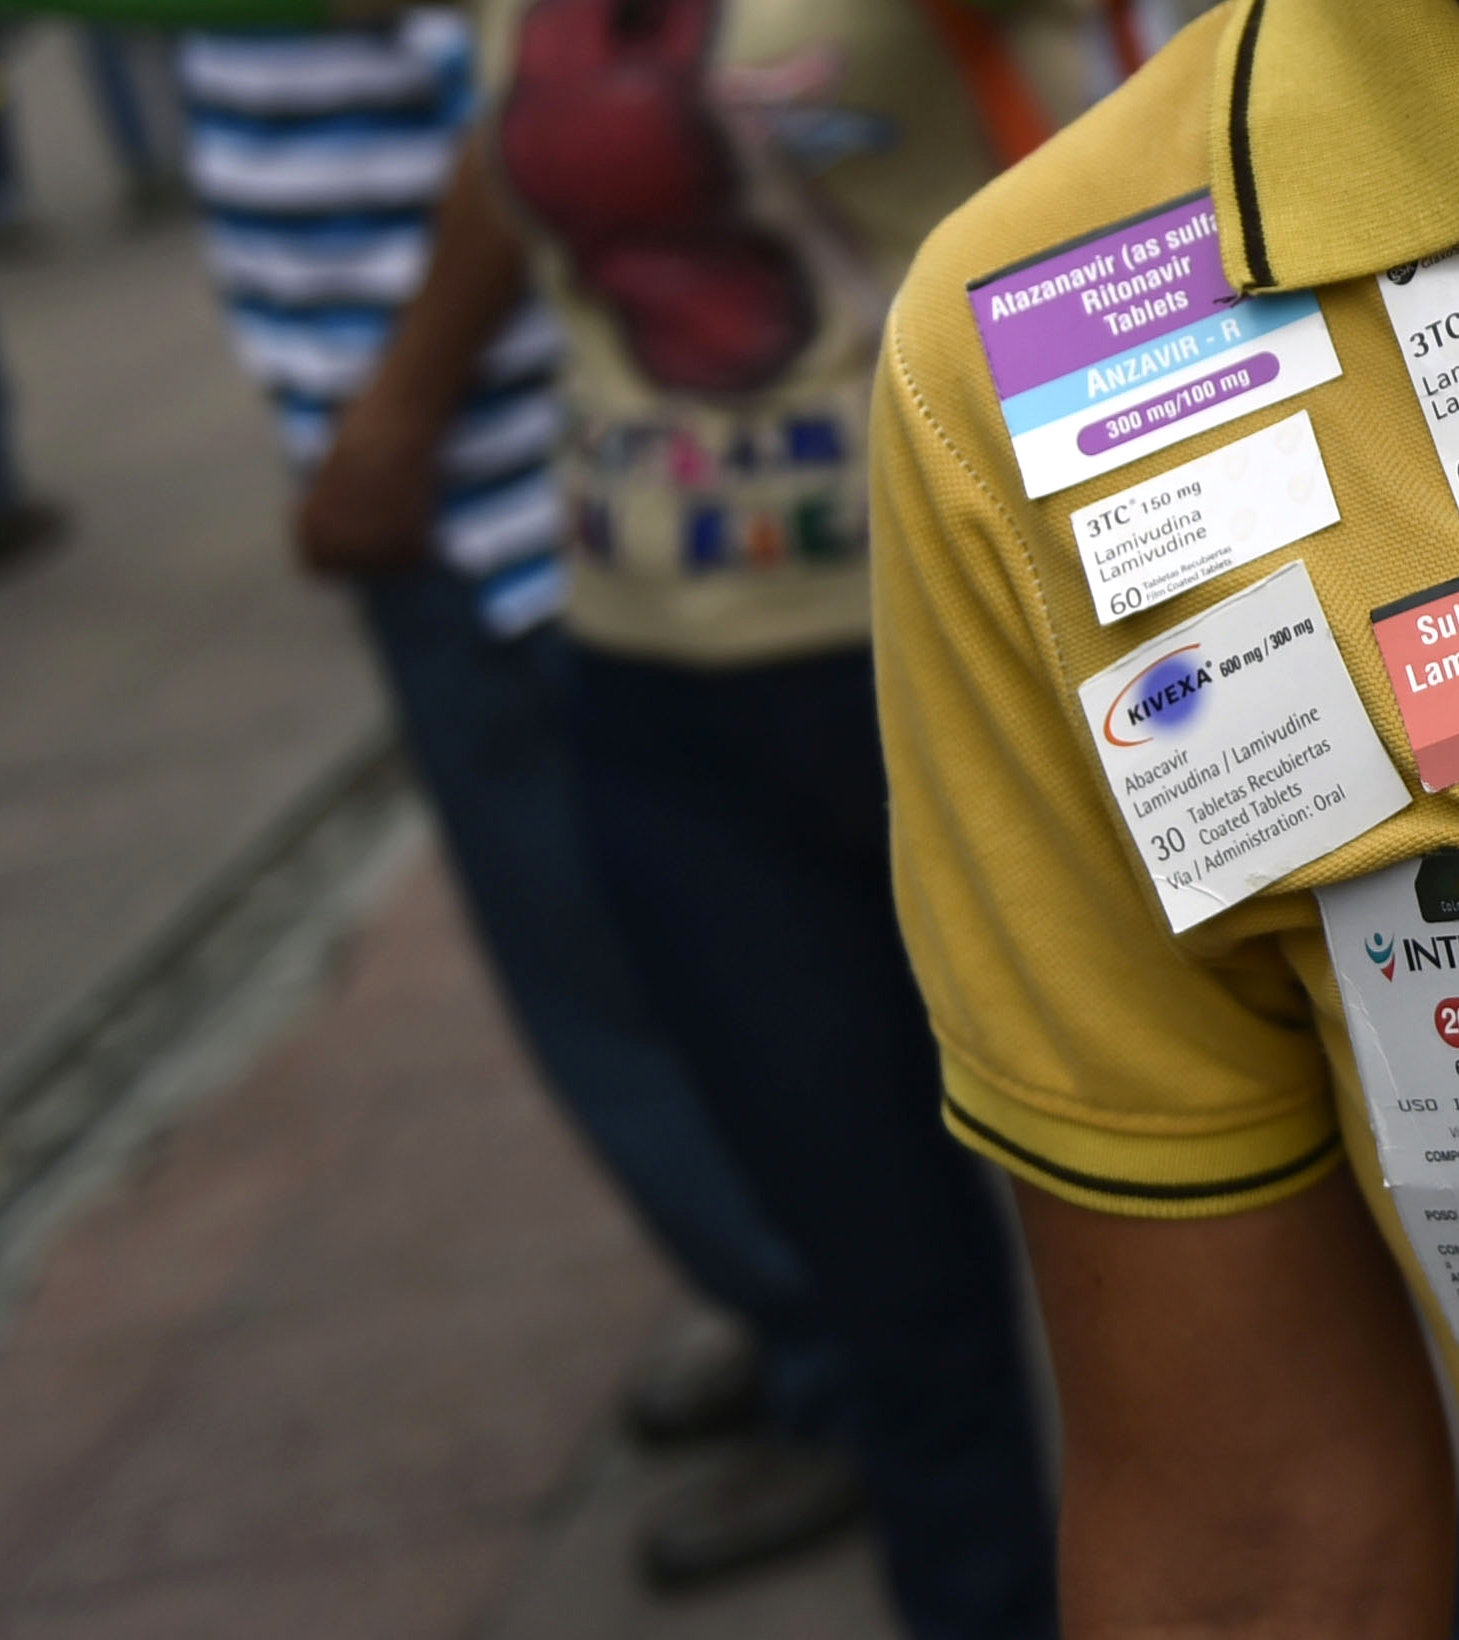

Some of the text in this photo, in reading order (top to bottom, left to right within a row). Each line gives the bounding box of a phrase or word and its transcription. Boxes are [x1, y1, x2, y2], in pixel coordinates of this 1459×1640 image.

[992, 255, 1114, 320] Atazanavir
[1122, 238, 1161, 271] (as
[1081, 257, 1190, 314] Ritonavir
[1103, 291, 1188, 335] Tablets
[1087, 335, 1199, 399] ANZAVIR
[1221, 319, 1241, 342] R
[1106, 369, 1250, 439] 300 mg/100 mg
[1125, 750, 1188, 795] Abacavir
[1133, 764, 1221, 818] Lamivudina
[1231, 708, 1320, 764] Lamivudine
[1187, 739, 1331, 824] Tabletas Recubiertas
[1151, 827, 1185, 861] 30
[1199, 783, 1302, 845] Coated Tablets
[1398, 1099, 1438, 1112] USO
